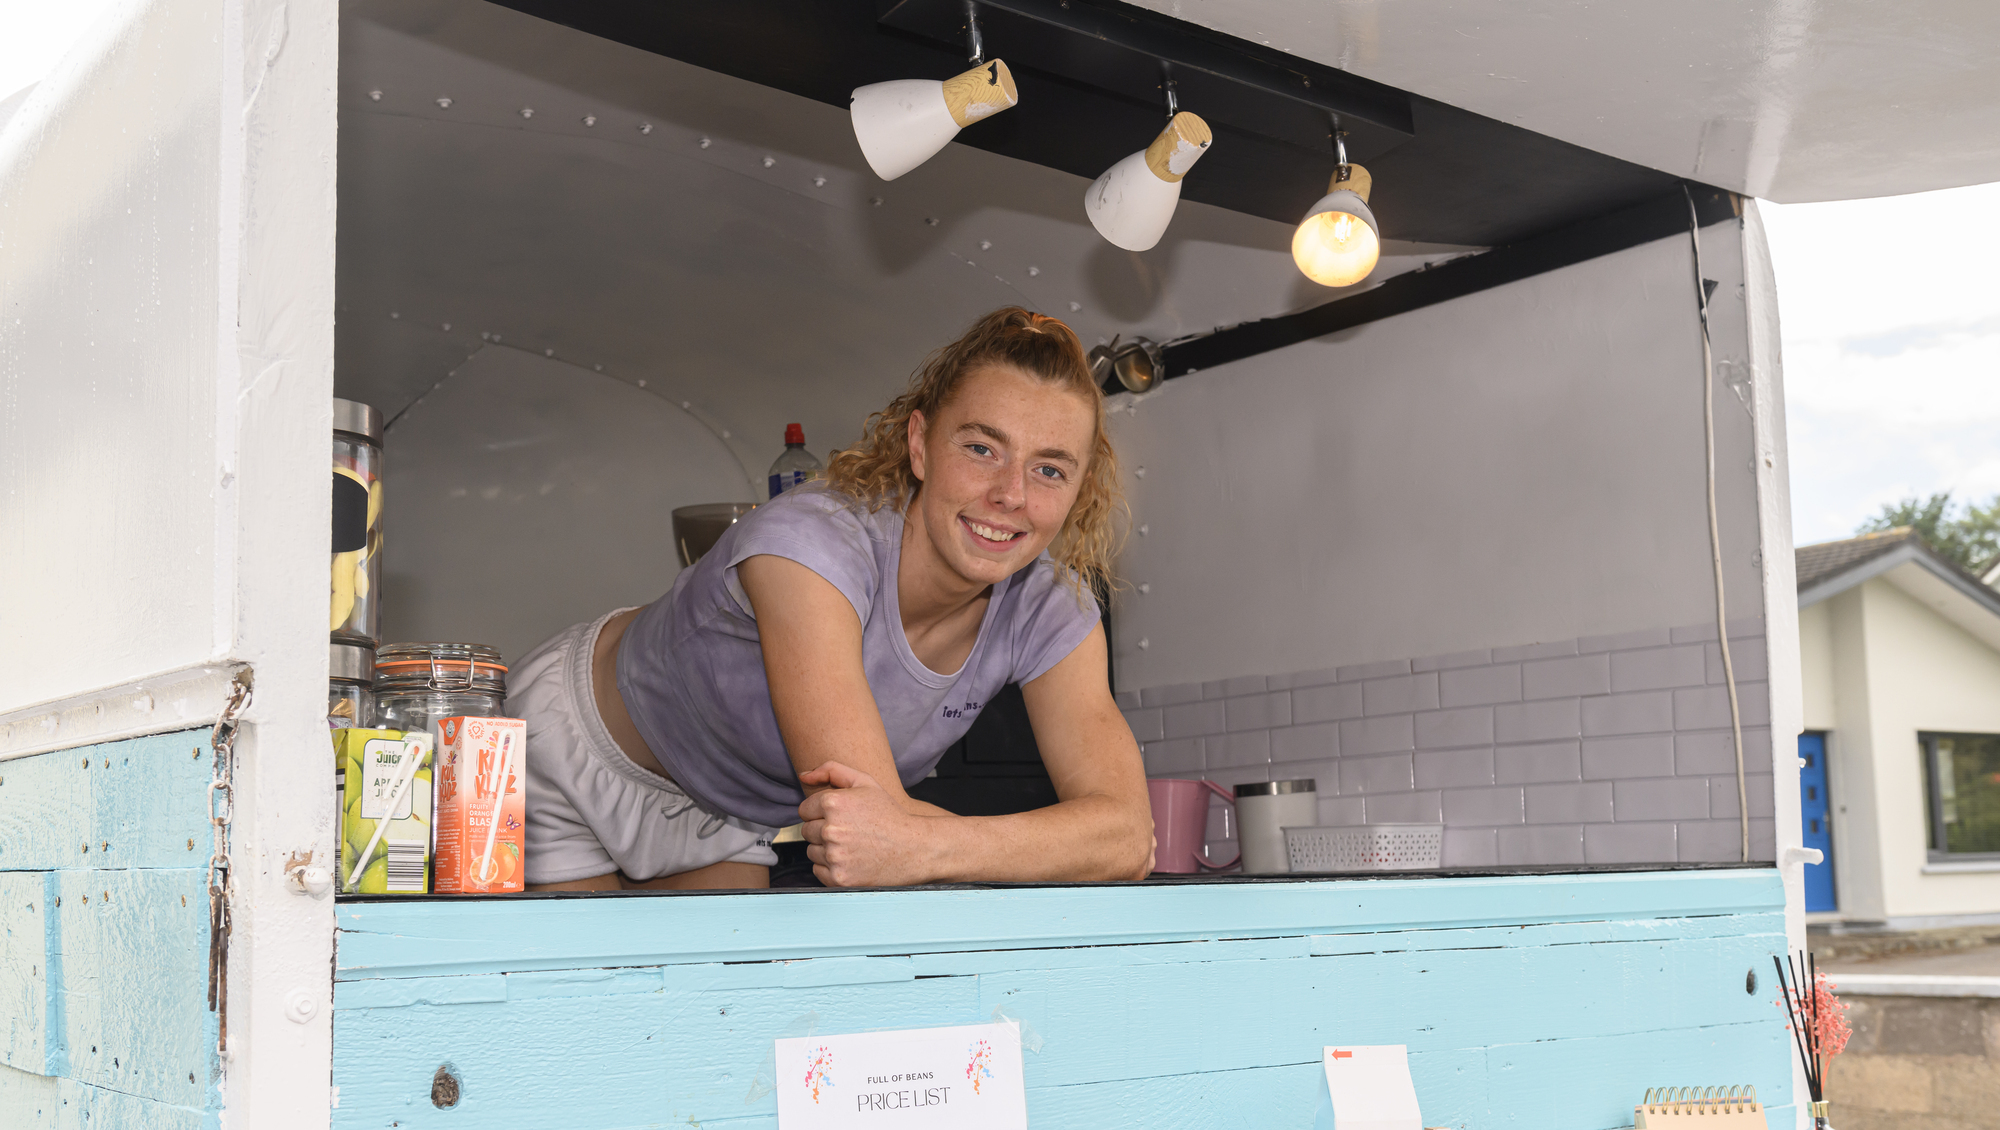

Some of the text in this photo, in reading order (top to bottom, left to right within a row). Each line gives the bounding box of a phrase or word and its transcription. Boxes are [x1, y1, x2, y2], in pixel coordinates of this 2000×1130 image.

[469, 817, 492, 827] BLAS
[867, 1071, 934, 1084] FULL OF BEANS
[857, 1086, 951, 1112] PRICE LIST
